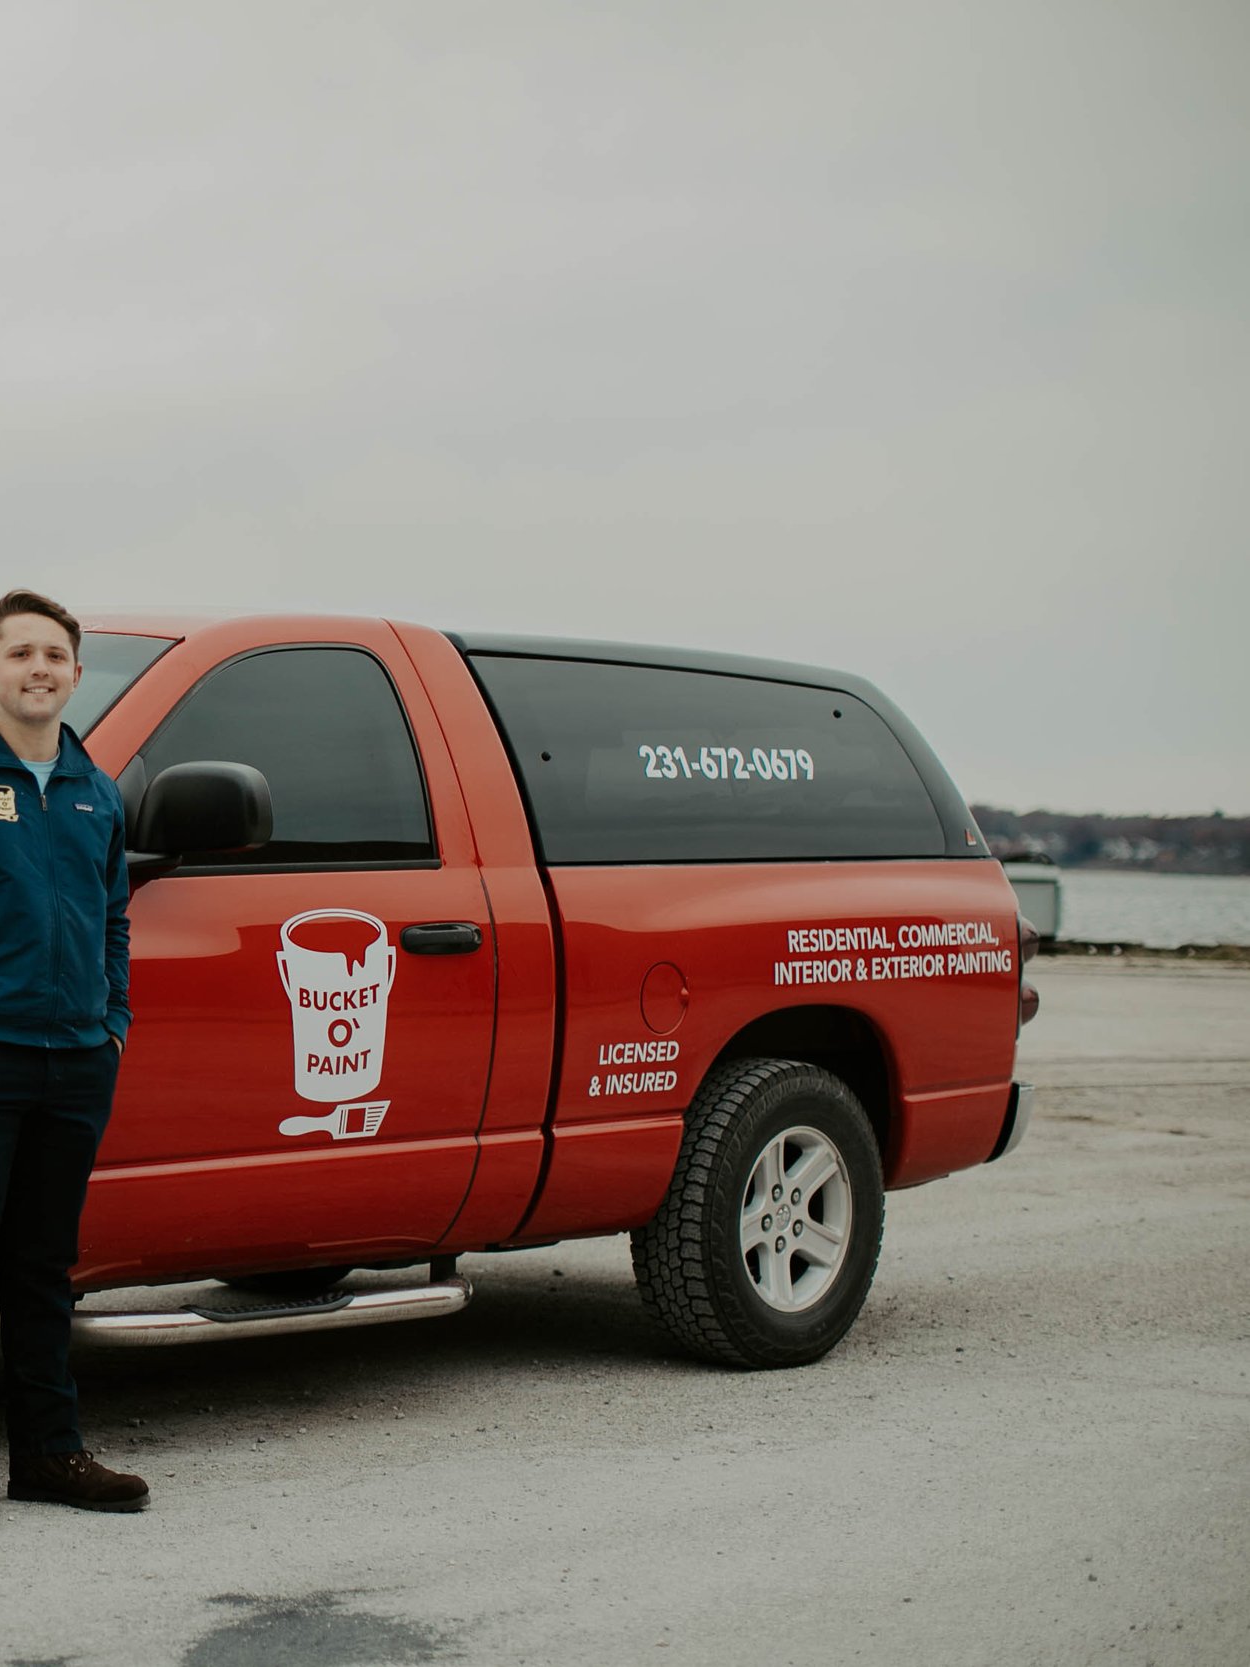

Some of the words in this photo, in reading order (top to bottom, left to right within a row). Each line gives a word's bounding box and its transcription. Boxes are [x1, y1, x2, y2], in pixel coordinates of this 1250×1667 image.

[638, 745, 814, 780] 231-672-0679
[788, 927, 895, 953] RESIDENTIAL,
[898, 922, 999, 948] COMMERCIAL,
[774, 958, 851, 985] INTERIOR
[855, 958, 868, 981] &
[871, 954, 945, 980] EXTERIOR
[948, 950, 1012, 975] PAINTING
[299, 983, 380, 1011] BUCKET
[307, 1049, 371, 1075] PAINT
[599, 1040, 680, 1065] LICENSED
[589, 1075, 601, 1097] &
[605, 1071, 677, 1095] INSURED
